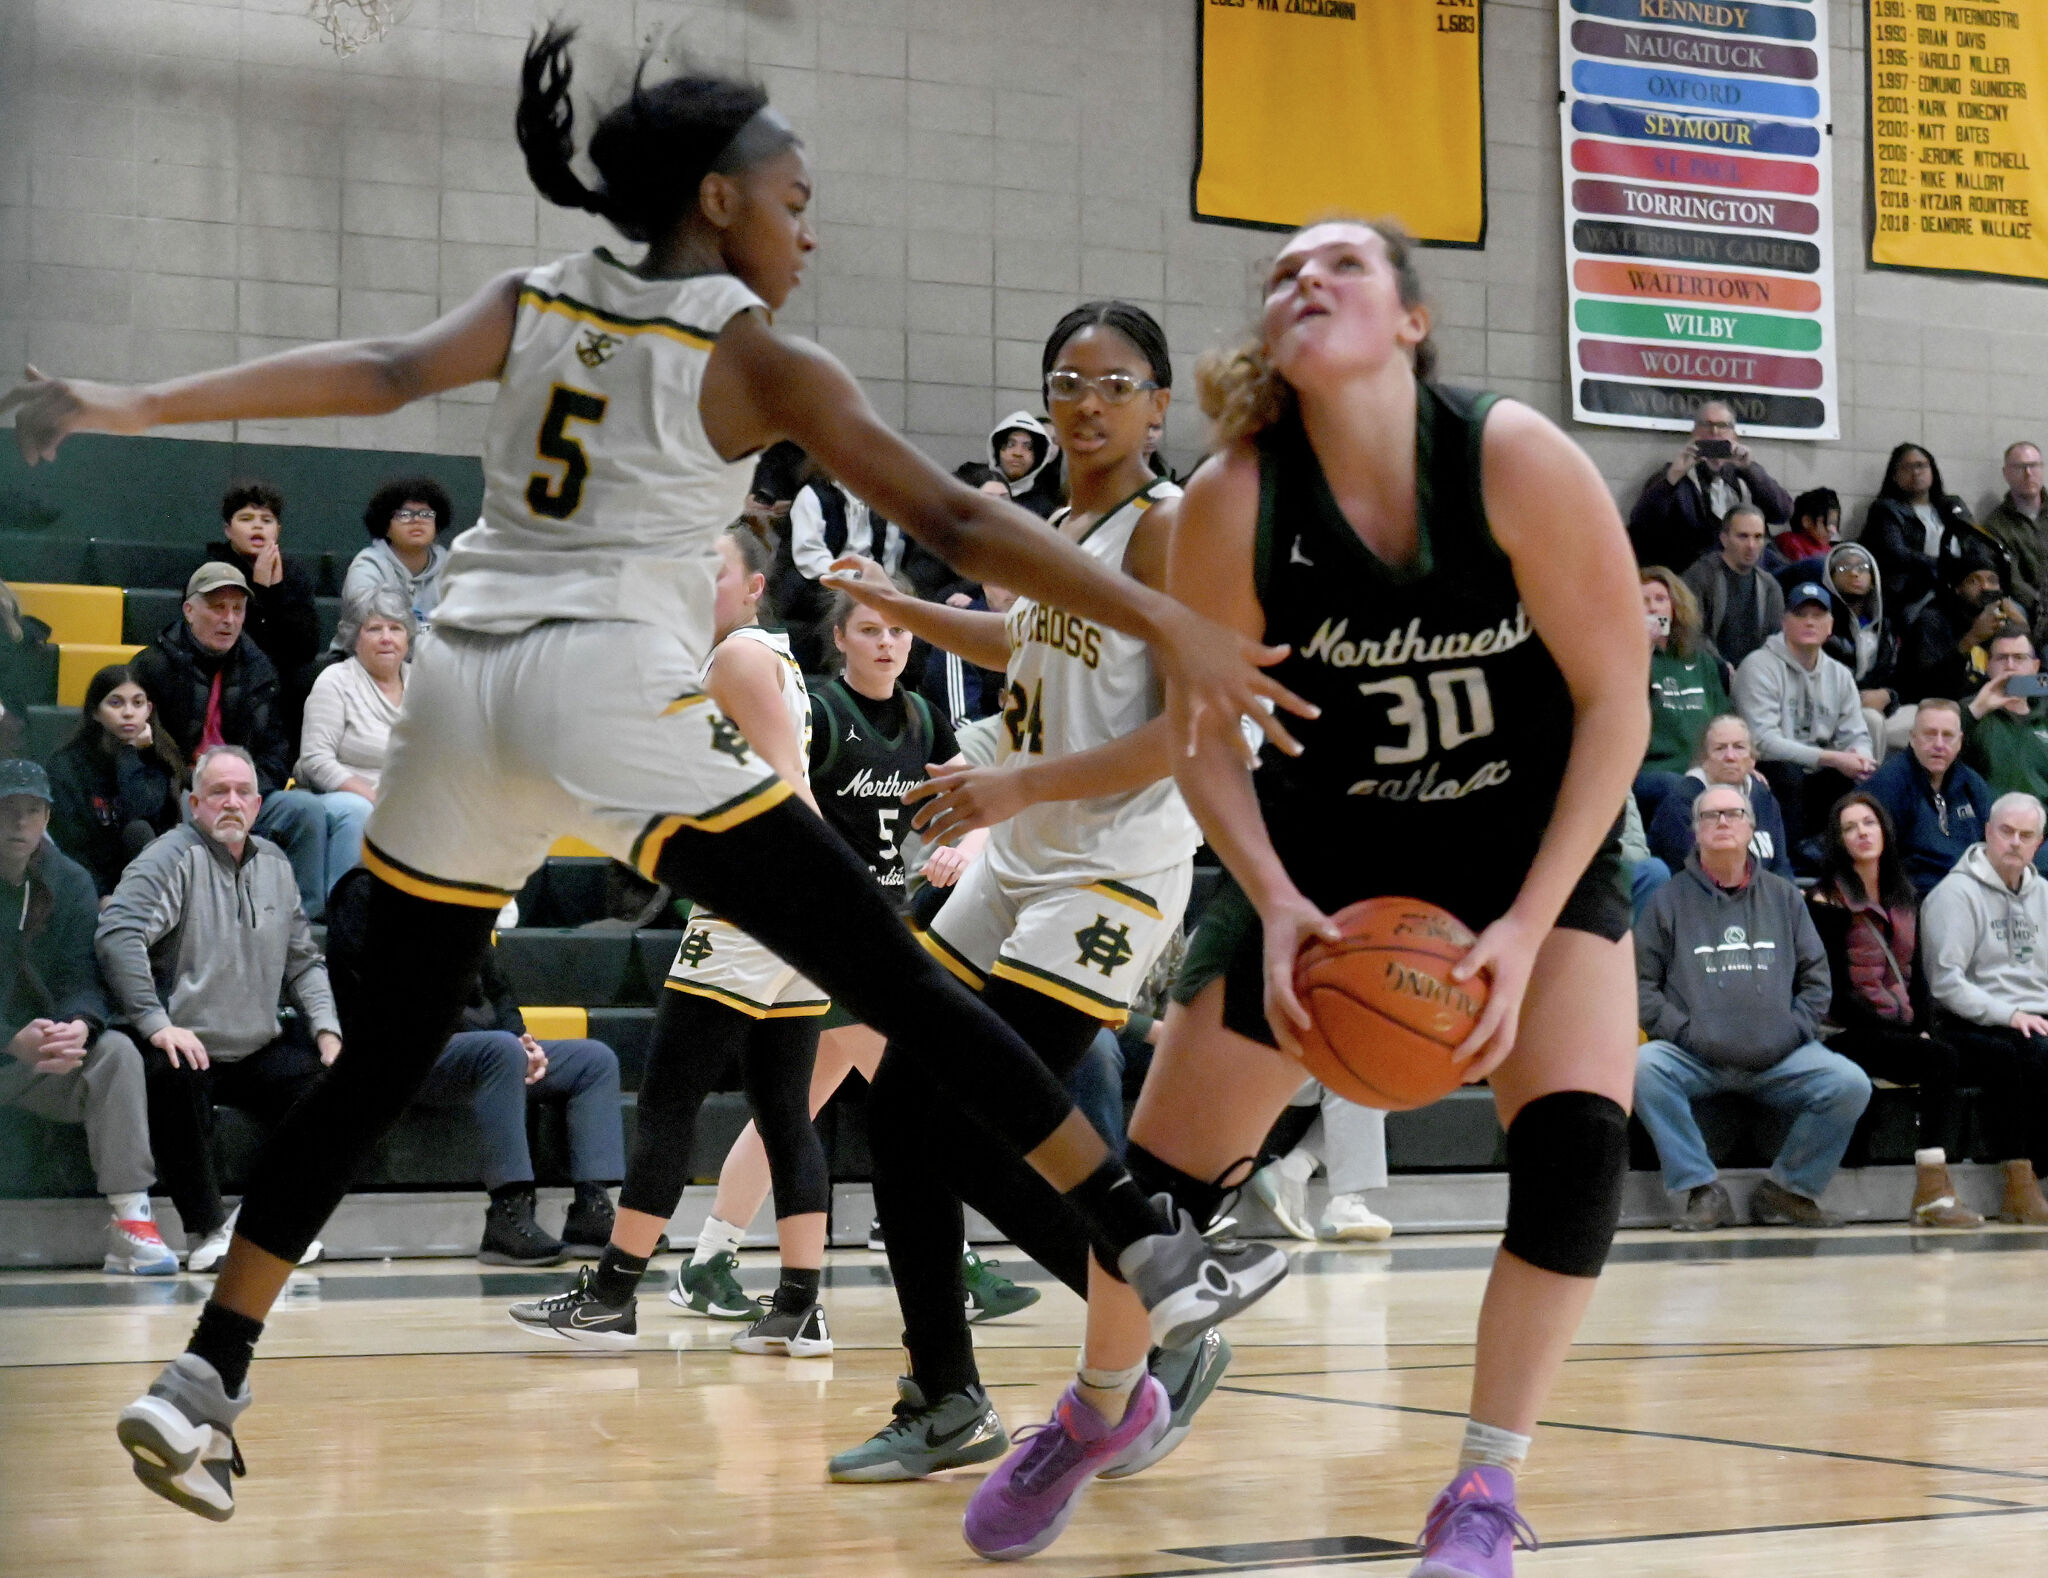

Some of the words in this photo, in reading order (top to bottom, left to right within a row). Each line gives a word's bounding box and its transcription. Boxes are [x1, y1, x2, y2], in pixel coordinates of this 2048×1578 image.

[1640, 0, 1749, 29] KENNEDY
[1916, 4, 1936, 22] ROB
[1624, 33, 1766, 69] NAUGATUCK
[1917, 28, 1948, 47] BRIAN
[1956, 31, 1986, 50] DAVIS
[1918, 52, 1960, 70] HAROLD
[1970, 56, 2010, 75] MILLER
[1648, 75, 1742, 106] OXFORD
[1918, 75, 1961, 95] EDMUND
[1970, 79, 2027, 100] SAUNDERS
[1918, 99, 1947, 117] MARK
[1644, 114, 1752, 145] SEYMOUR
[1918, 123, 1945, 141] MATT
[1956, 126, 1990, 145] BATES
[1918, 147, 1965, 166] JEROME
[1974, 150, 2030, 170] MITCHELL
[1920, 170, 1946, 188] MIKE
[1956, 172, 2005, 192] MALLORY
[1623, 188, 1775, 225] TORRINGTON
[1969, 196, 2029, 216] ROUNTREE
[1921, 216, 1974, 235] DEANDRE
[1981, 219, 2032, 239] WALLACE
[1584, 227, 1720, 259] WATERBURY
[1627, 269, 1770, 302] WATERTOWN
[1663, 312, 1739, 339] WILBY
[1640, 351, 1757, 380] WOLCOTT
[1629, 388, 1767, 421] WOODND
[523, 381, 609, 521] 5
[1300, 602, 1533, 668] Northwest
[1005, 678, 1044, 756] 24
[1358, 667, 1495, 764] 30
[878, 808, 899, 860] 5
